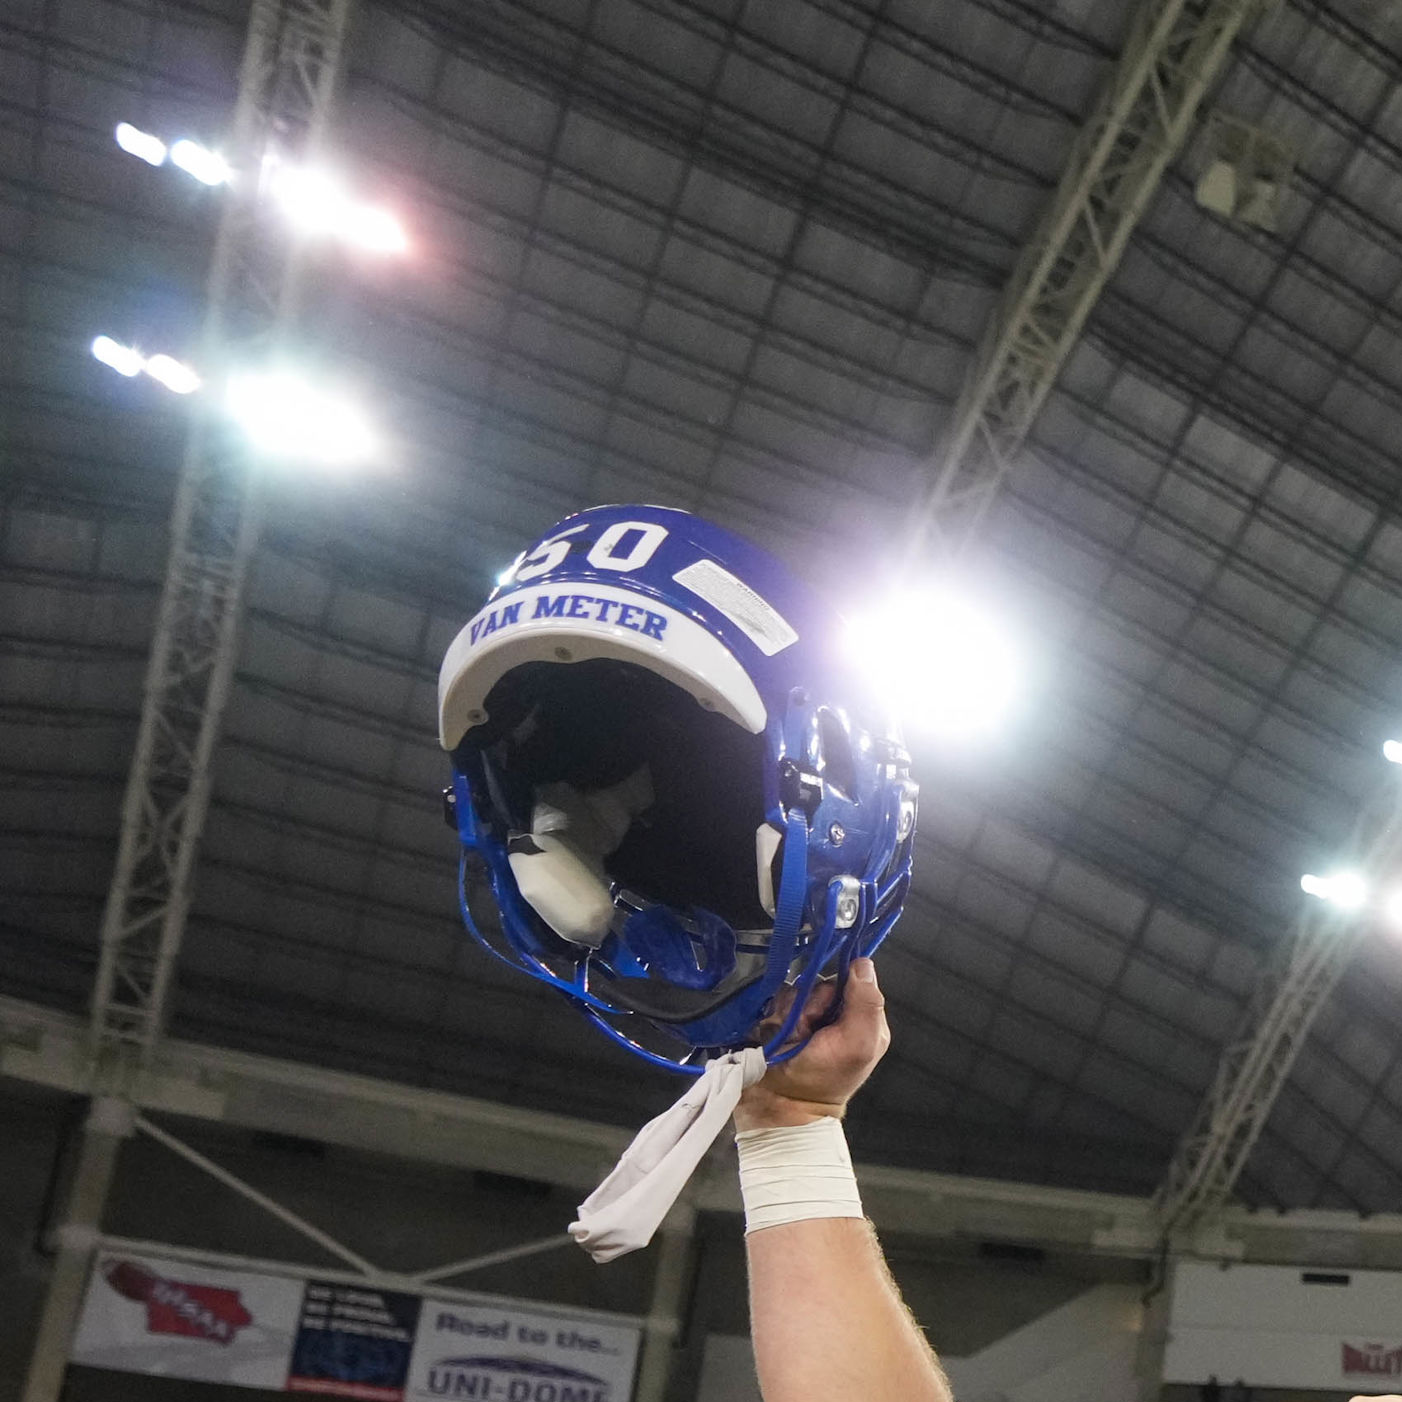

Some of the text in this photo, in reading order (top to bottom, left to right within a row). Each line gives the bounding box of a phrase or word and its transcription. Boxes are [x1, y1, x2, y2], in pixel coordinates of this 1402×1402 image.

[515, 521, 669, 582] 50
[470, 600, 523, 647] VAN
[535, 594, 668, 643] METER
[436, 1312, 511, 1341] Road
[517, 1326, 548, 1346] to
